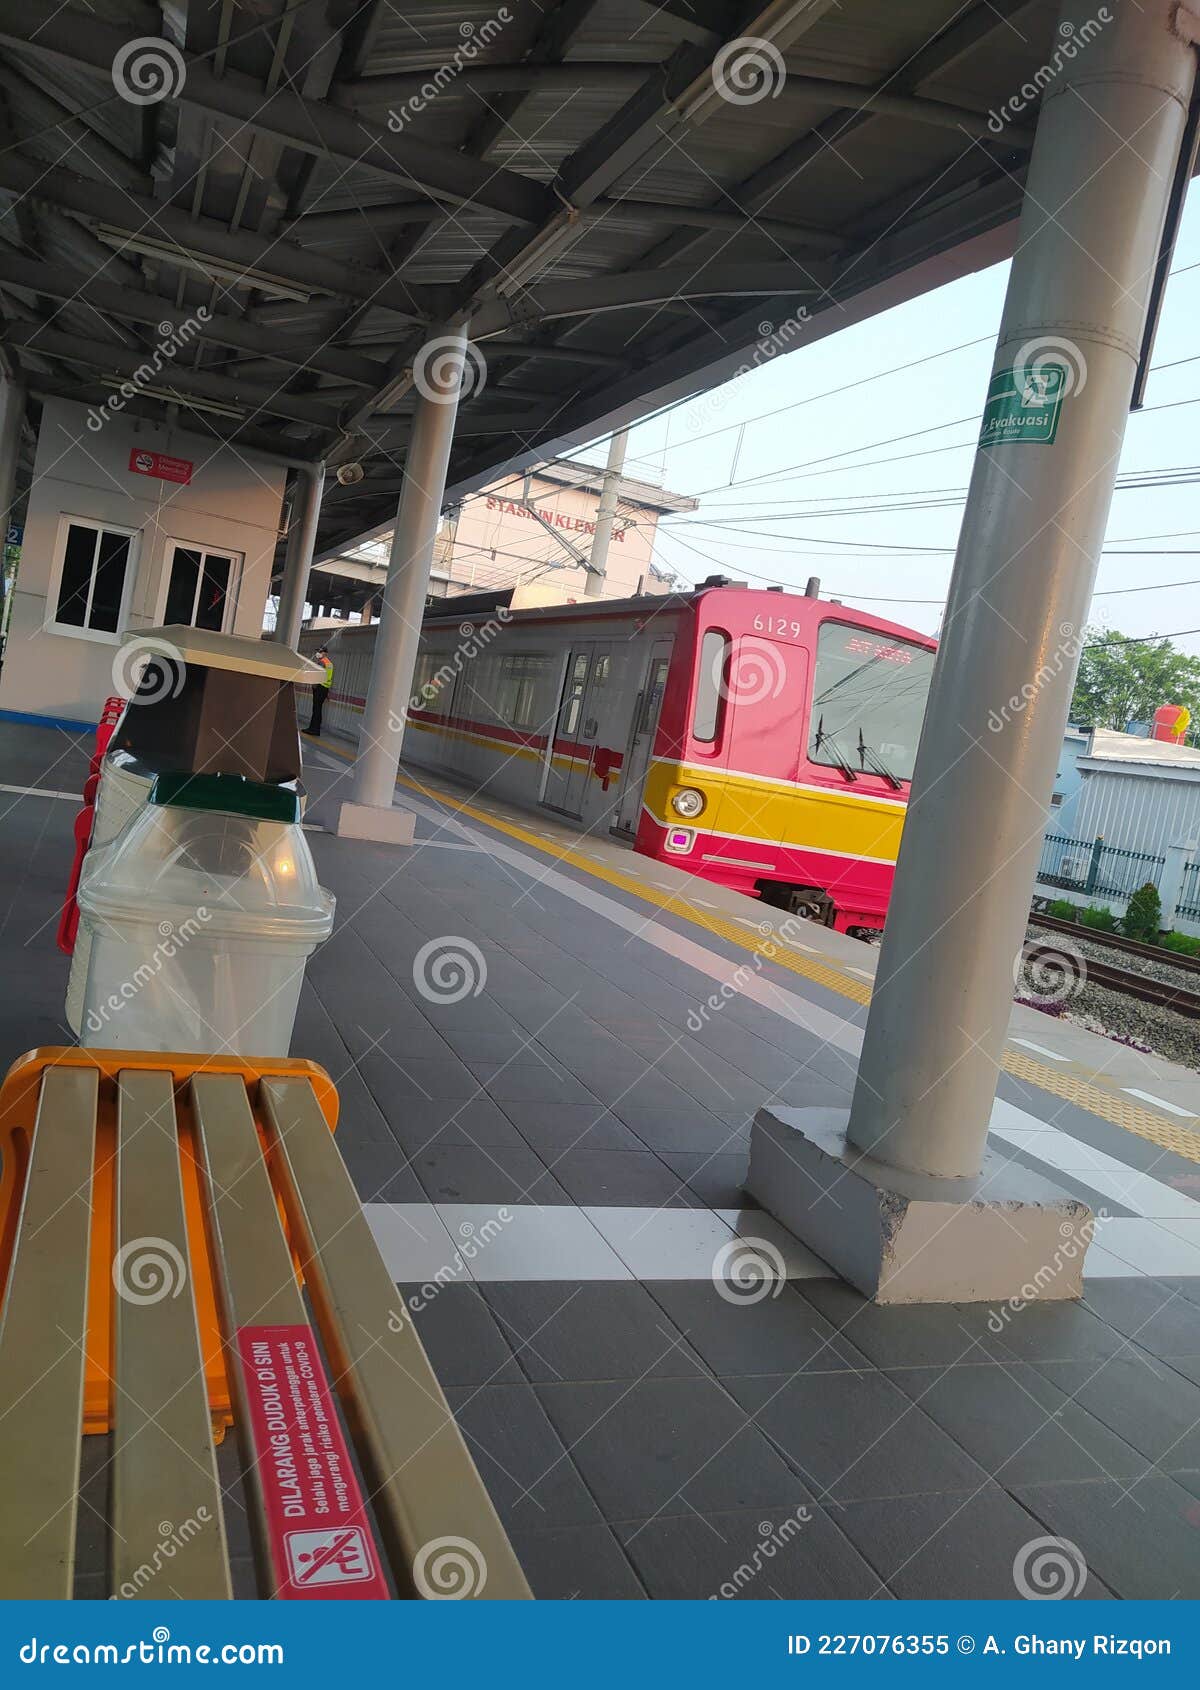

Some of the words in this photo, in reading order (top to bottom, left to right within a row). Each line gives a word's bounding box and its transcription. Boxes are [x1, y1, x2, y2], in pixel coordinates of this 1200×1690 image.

[990, 413, 1049, 429] Evakuasi
[555, 513, 625, 543] KLENER
[753, 614, 801, 639] 6129
[251, 1342, 273, 1366] SINI
[277, 1342, 293, 1364] untuk
[294, 1341, 315, 1379] COVID-19
[256, 1367, 277, 1381] DI
[260, 1383, 288, 1432] DUDUK
[307, 1380, 327, 1422] penularan
[298, 1431, 319, 1456] jarak
[316, 1423, 334, 1449] risiko
[270, 1433, 306, 1518] DILARANG
[307, 1457, 326, 1481] jaga
[321, 1451, 351, 1513] mengurangi
[312, 1481, 330, 1514] Selalu
